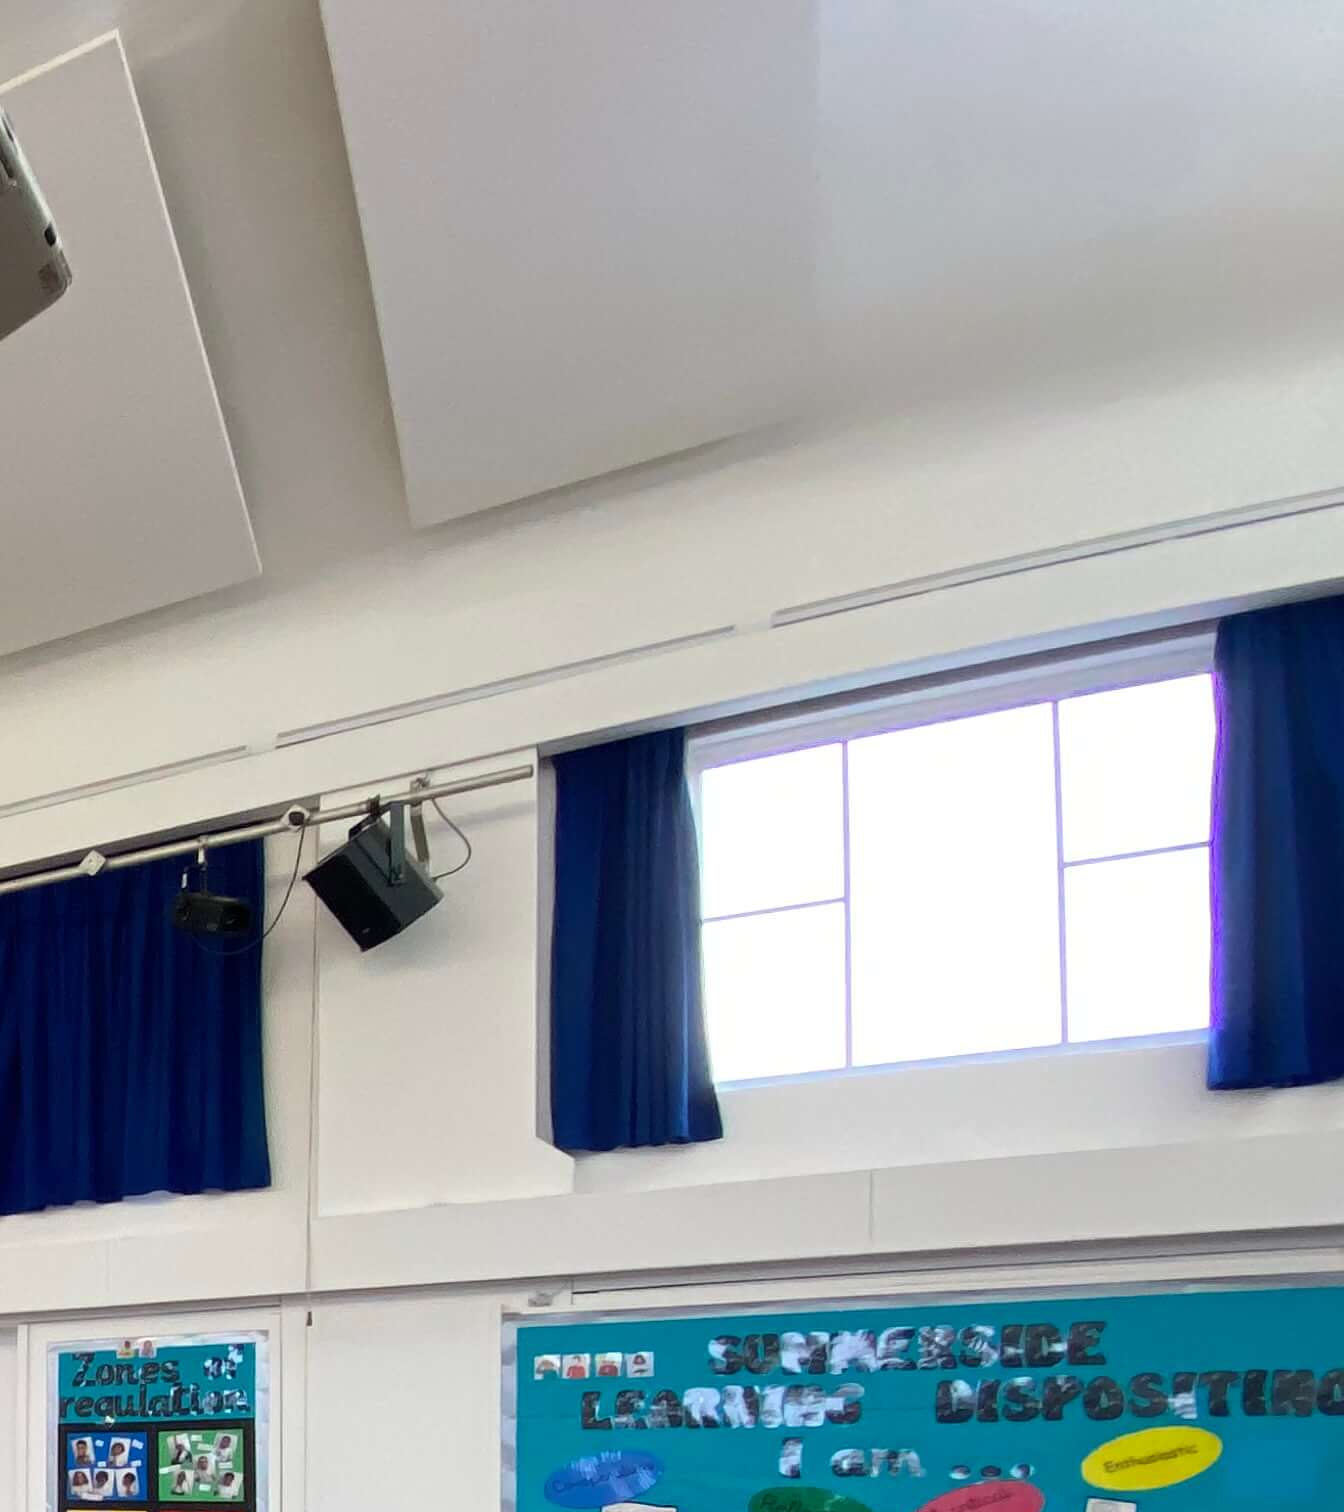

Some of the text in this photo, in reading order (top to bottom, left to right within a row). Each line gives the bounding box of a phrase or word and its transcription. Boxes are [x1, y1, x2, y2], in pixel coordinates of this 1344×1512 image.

[71, 1351, 180, 1388] Zones
[708, 1320, 1107, 1376] SUMMERSIDE
[580, 1382, 866, 1430] LEARNING
[778, 1436, 804, 1479] I
[830, 1447, 928, 1478] am
